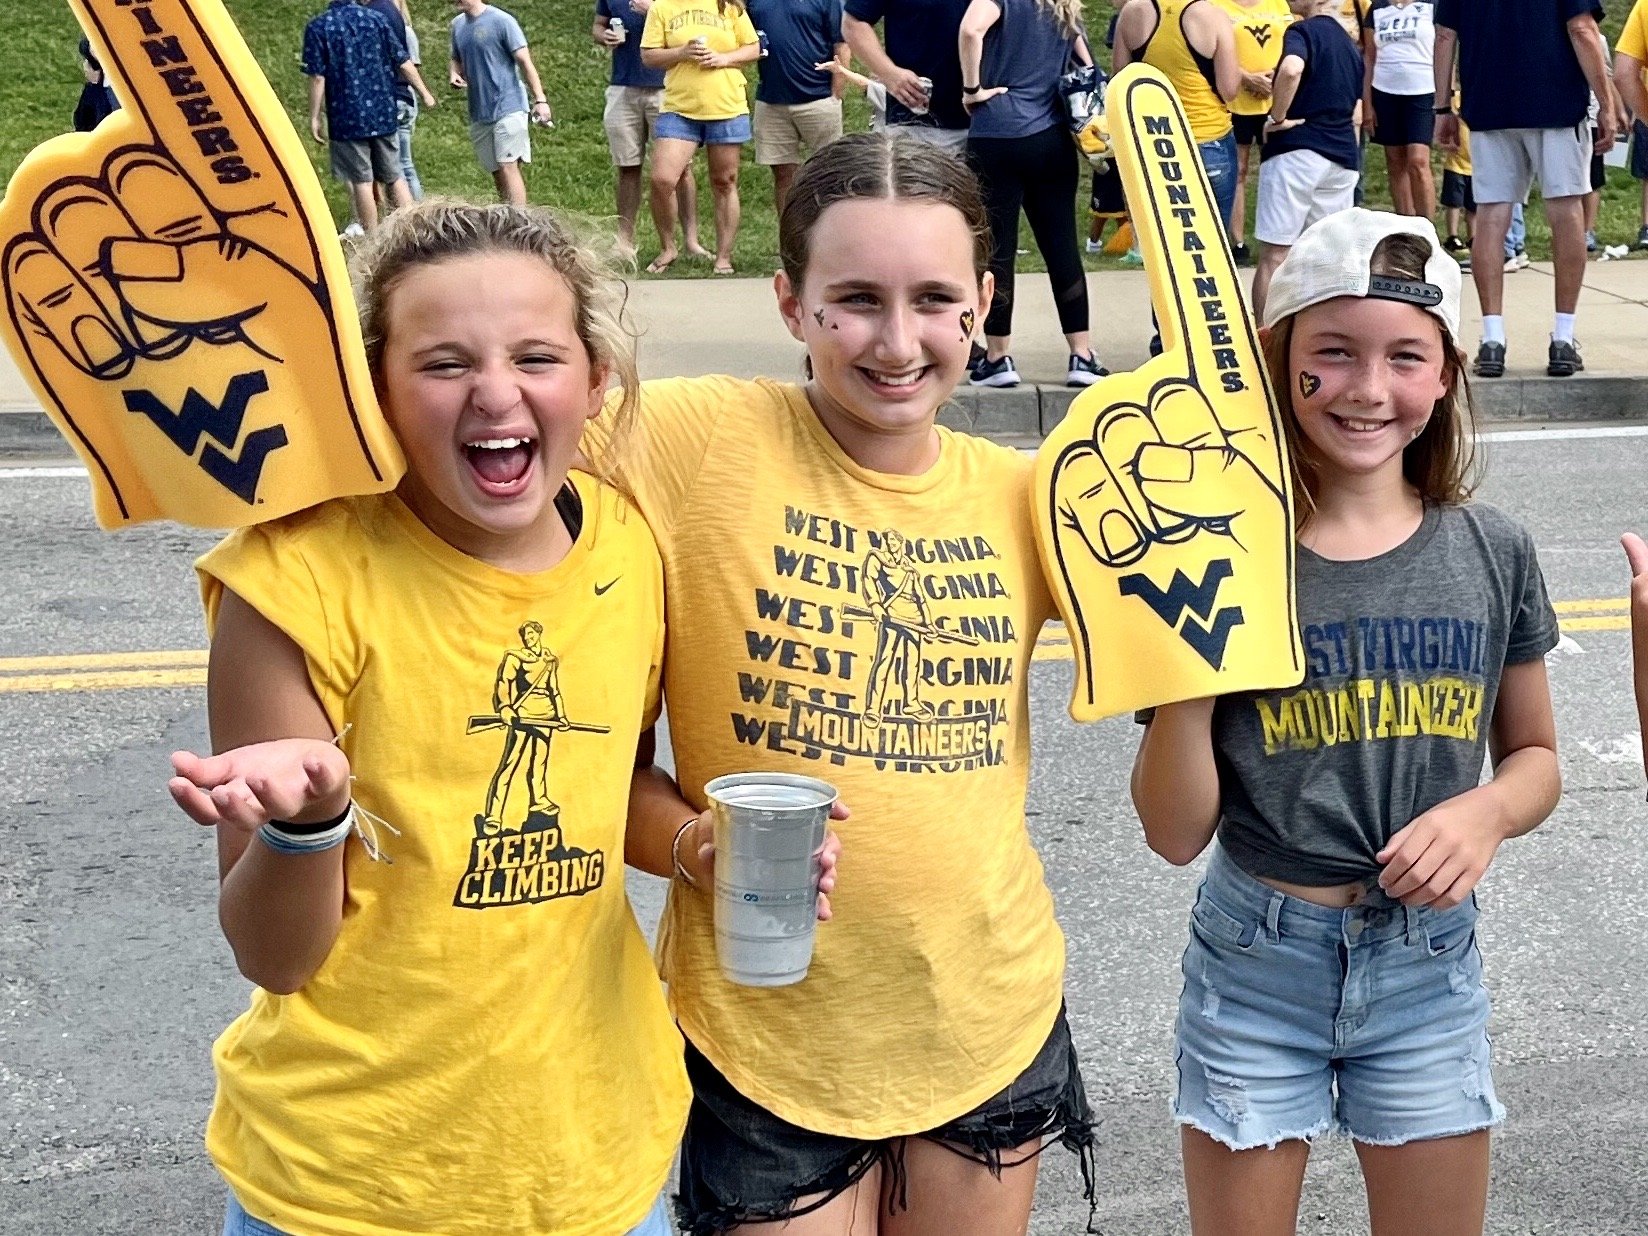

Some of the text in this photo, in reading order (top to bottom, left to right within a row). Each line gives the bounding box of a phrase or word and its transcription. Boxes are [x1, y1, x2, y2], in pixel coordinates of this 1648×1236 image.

[1379, 17, 1420, 31] WEST
[115, 0, 254, 184] INEERS
[1142, 115, 1244, 393] MOUNTAINEERS
[785, 505, 996, 564] WEST VRGINIA
[774, 545, 860, 594] WEST
[745, 630, 1013, 687] WEST IRGINIA
[1304, 621, 1350, 678] ST
[731, 712, 846, 767] WE
[797, 706, 988, 758] MOUNTAINEERS
[474, 827, 560, 872] KEEP
[459, 852, 605, 905] CLIMBING
